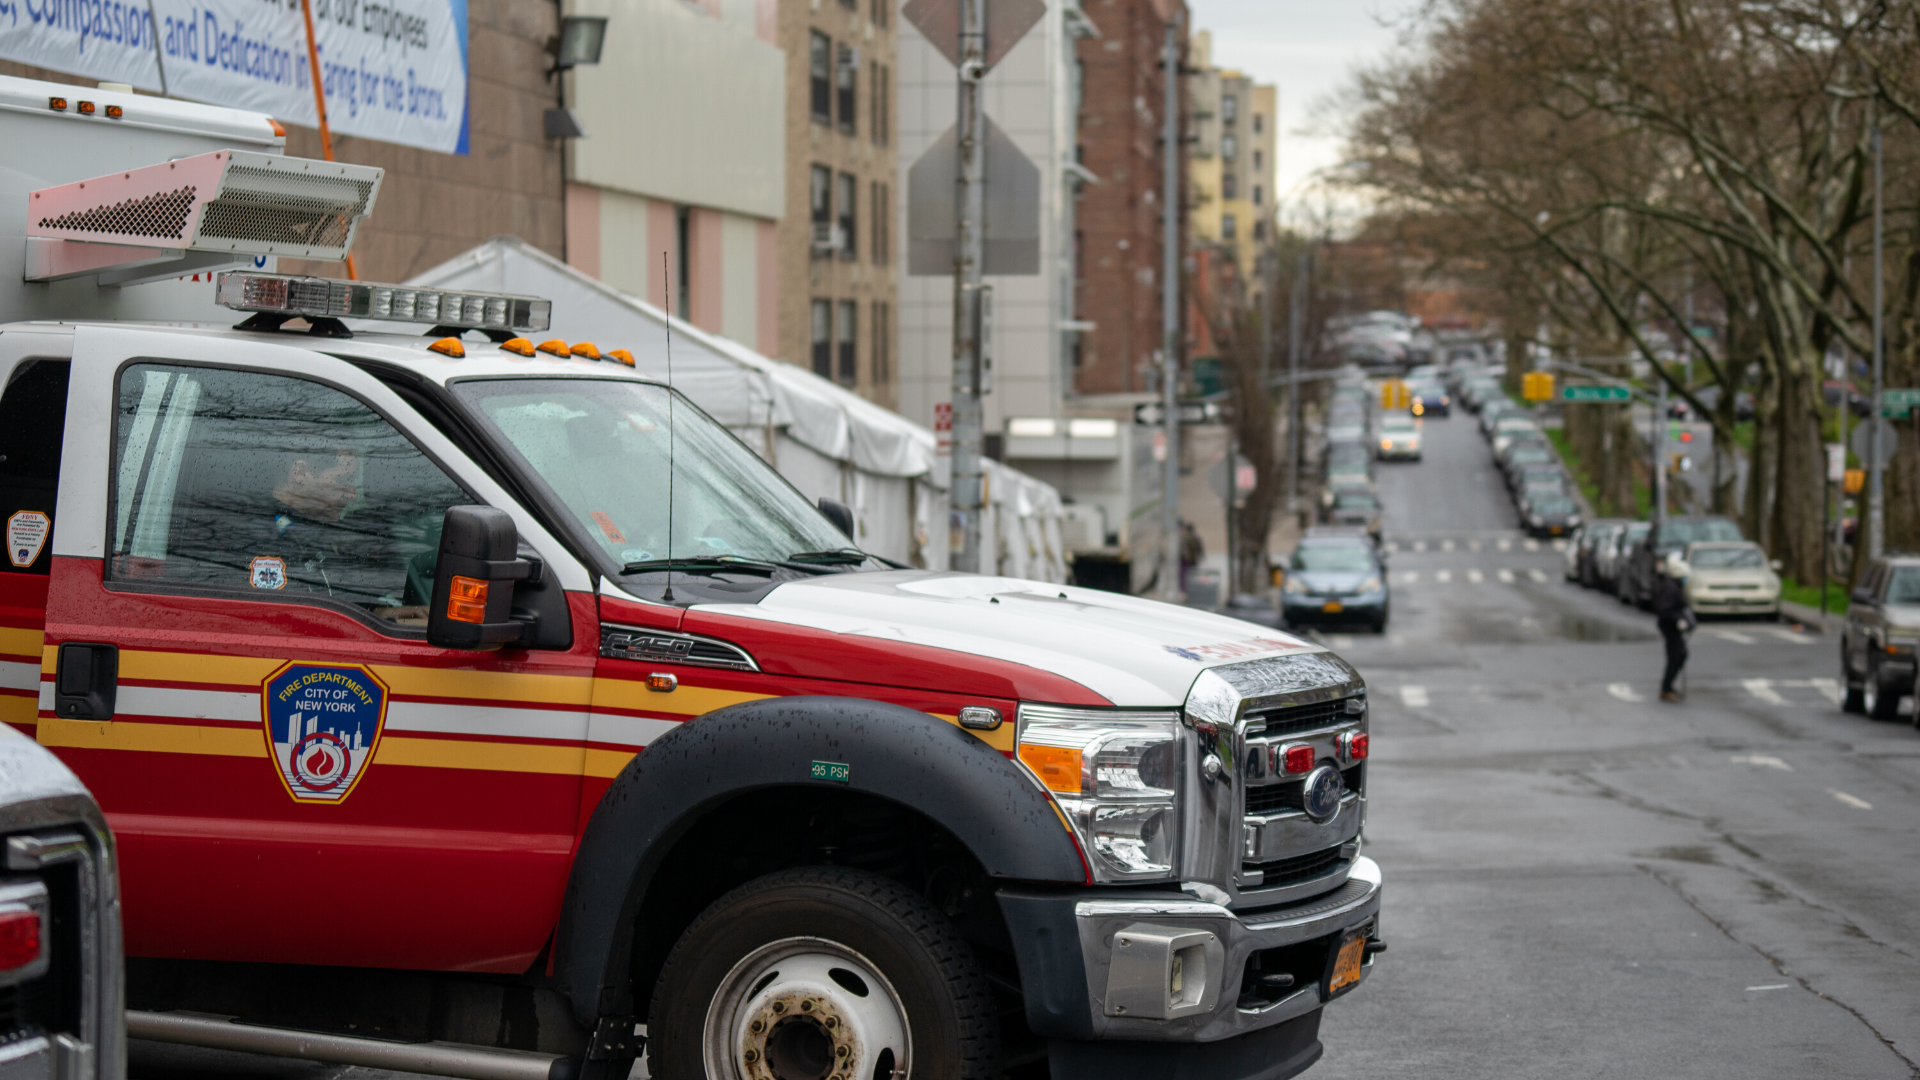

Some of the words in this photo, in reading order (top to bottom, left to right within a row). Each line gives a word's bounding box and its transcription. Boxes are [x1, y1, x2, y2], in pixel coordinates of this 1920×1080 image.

[363, 0, 428, 57] Employees
[165, 7, 199, 63] and
[204, 9, 292, 87] Dedication
[295, 39, 310, 90] in
[316, 44, 357, 118] aring
[360, 55, 380, 107] for
[384, 65, 404, 113] the
[408, 68, 447, 120] Bronx.
[278, 679, 303, 702] FIRE
[302, 672, 373, 706] DEPARTMENT
[304, 688, 331, 699] CITY
[332, 689, 348, 700] OF
[295, 700, 323, 711] NEW
[324, 701, 356, 713] YORK
[814, 764, 826, 776] 95
[830, 766, 847, 778] PSI
